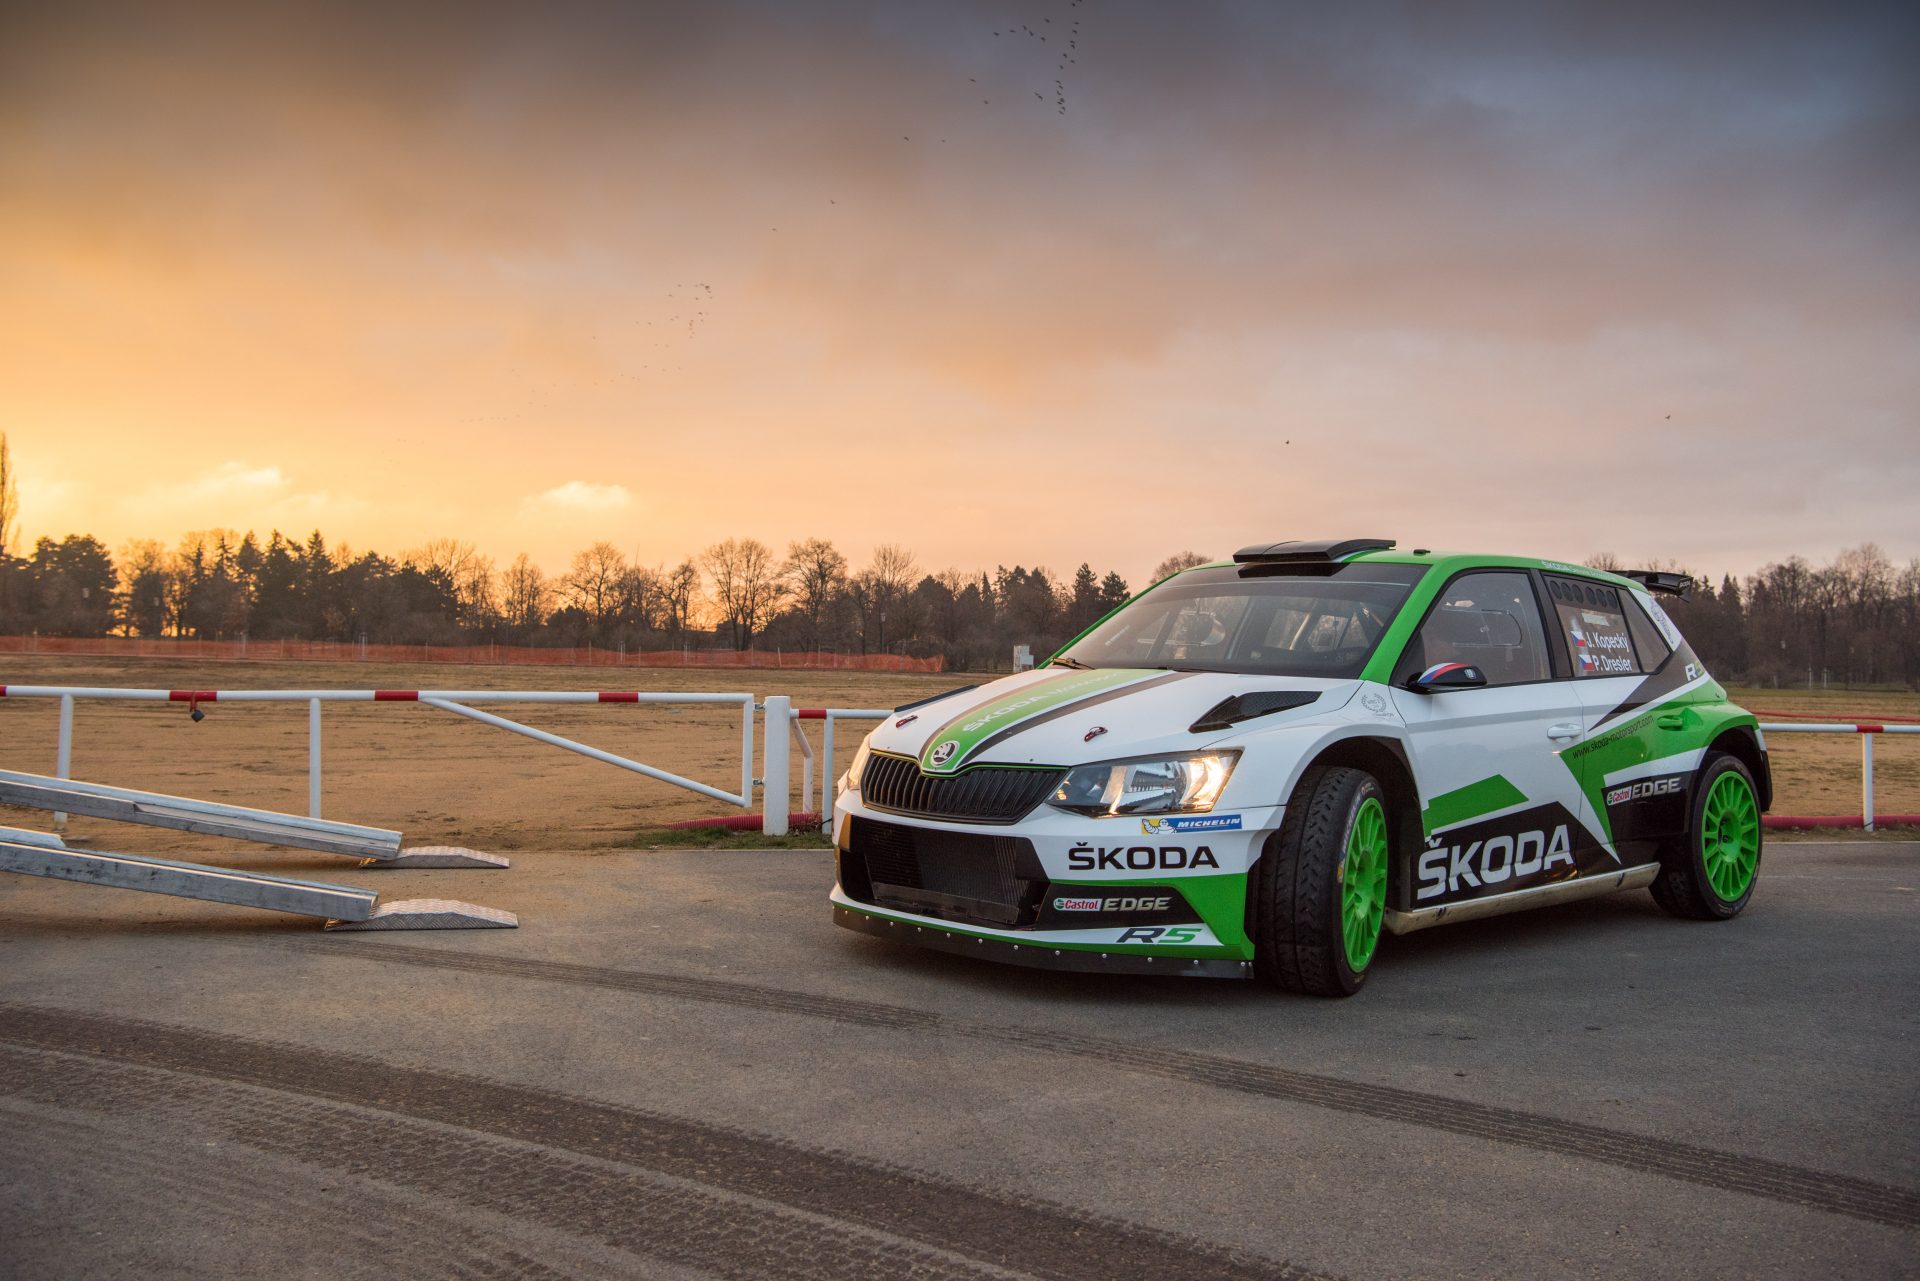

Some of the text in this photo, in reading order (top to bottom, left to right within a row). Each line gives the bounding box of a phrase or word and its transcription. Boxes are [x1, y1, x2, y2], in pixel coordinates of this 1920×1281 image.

[1586, 632, 1629, 653] J. Kopecký
[1592, 655, 1632, 671] P. Dresler
[1632, 777, 1682, 799] EDGE
[1177, 817, 1241, 829] MICHELIN
[1068, 842, 1220, 870] ŠKODA
[1417, 824, 1574, 900] ŠKODA
[1064, 897, 1173, 912] Castrol EDGE
[1116, 928, 1202, 944] R5
